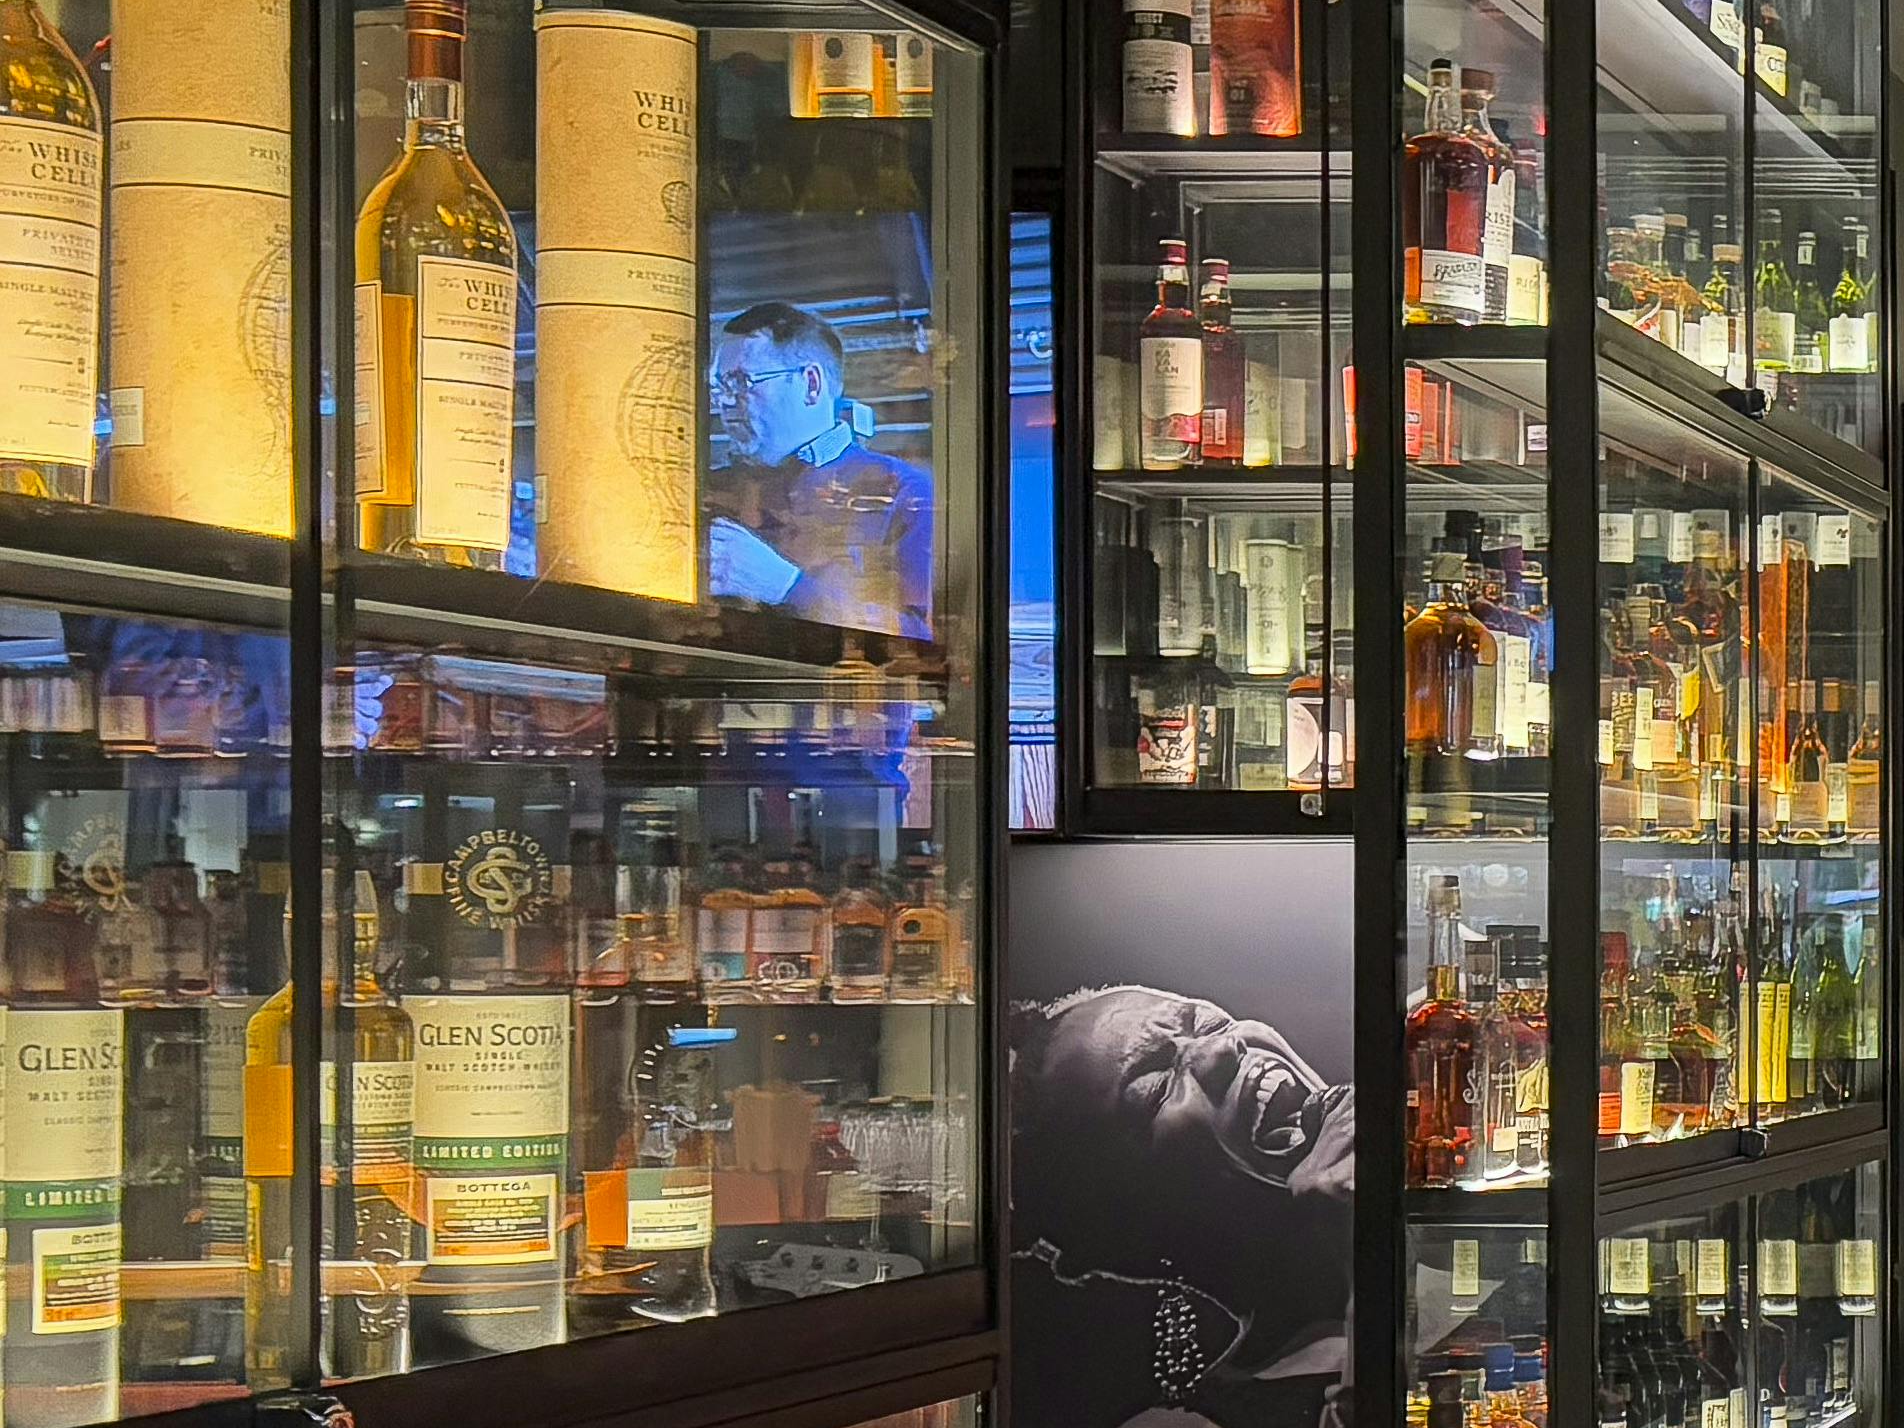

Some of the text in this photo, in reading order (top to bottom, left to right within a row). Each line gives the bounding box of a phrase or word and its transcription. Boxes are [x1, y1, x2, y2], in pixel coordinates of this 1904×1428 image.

[419, 1024, 483, 1048] GLEN
[18, 1043, 99, 1072] GLEN
[422, 1144, 494, 1160] LIMITED
[456, 1182, 532, 1196] BOTTEGA
